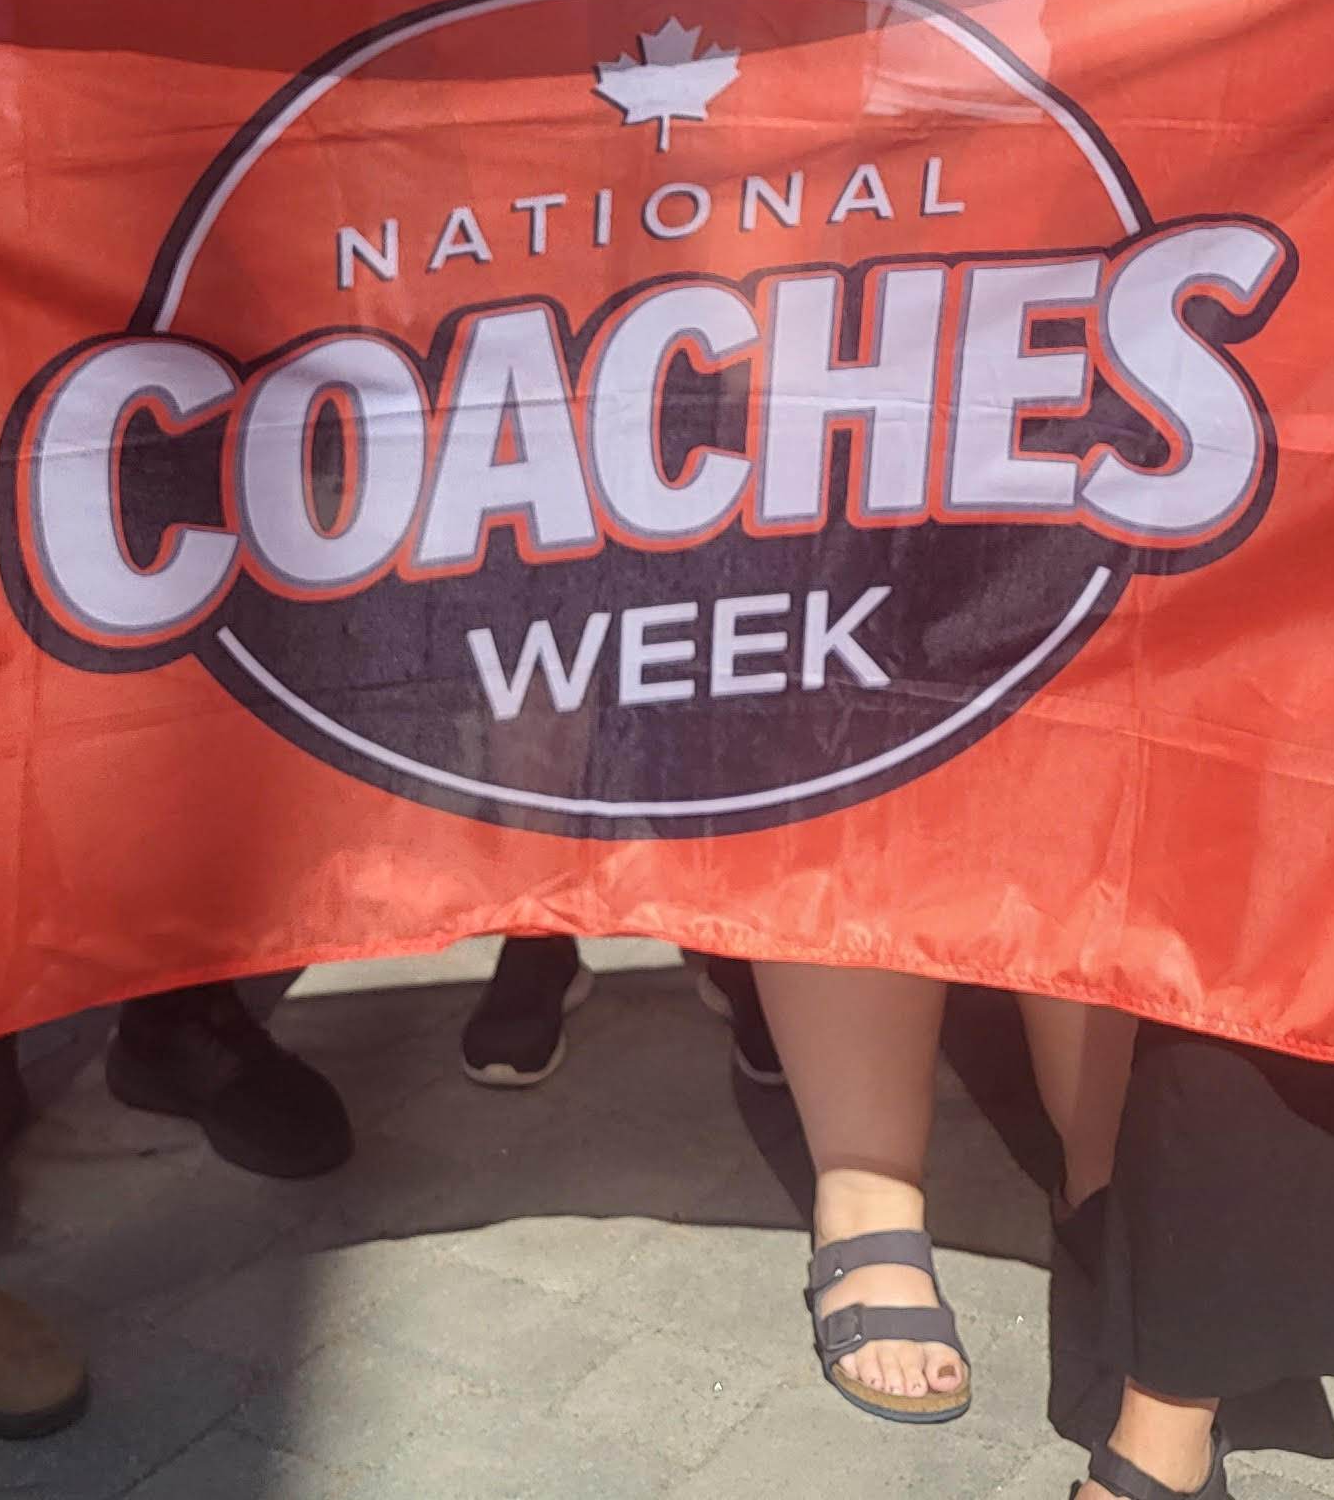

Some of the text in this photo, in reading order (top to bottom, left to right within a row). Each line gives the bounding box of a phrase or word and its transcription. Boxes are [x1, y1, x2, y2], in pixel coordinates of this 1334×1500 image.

[337, 156, 966, 290] NATIONAL
[28, 224, 1279, 634] COACHES
[467, 585, 892, 721] WEEK
